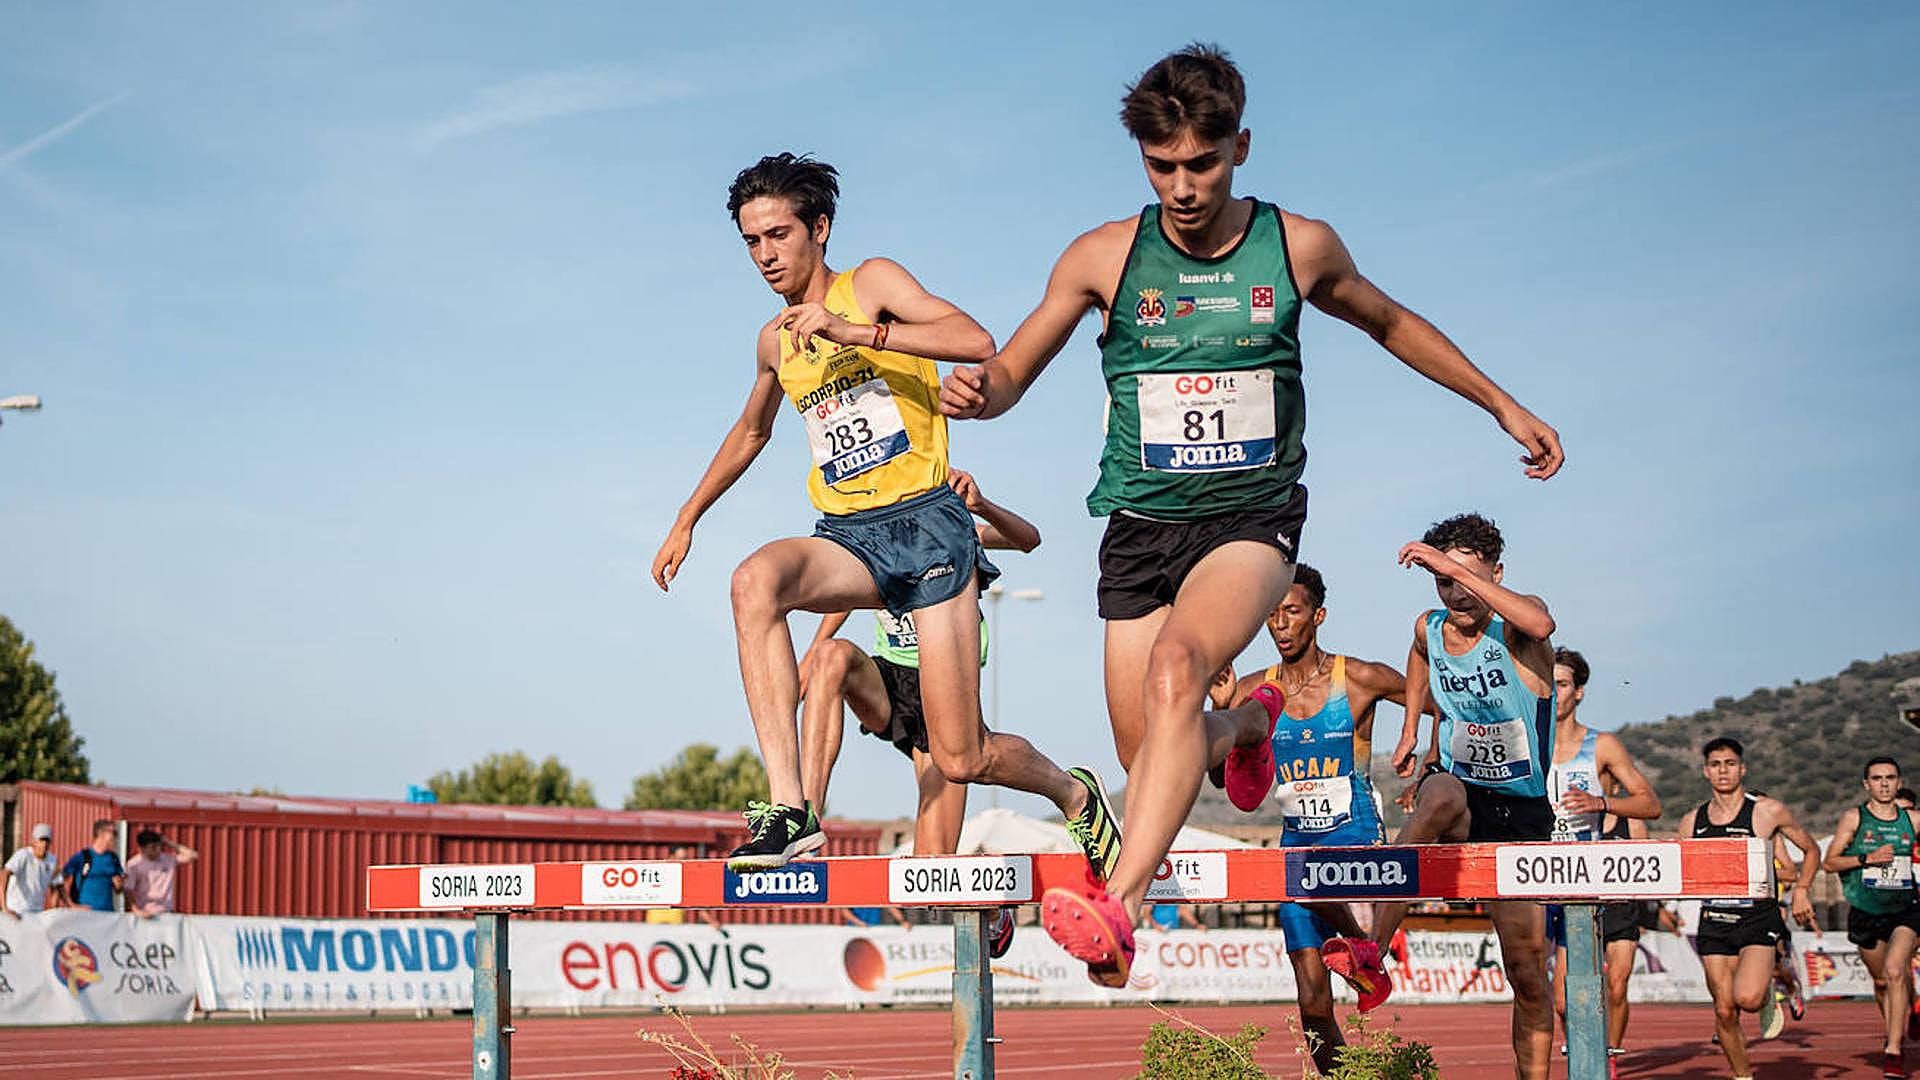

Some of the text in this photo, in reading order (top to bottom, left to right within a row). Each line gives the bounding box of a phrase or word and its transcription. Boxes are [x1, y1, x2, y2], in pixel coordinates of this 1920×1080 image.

[1179, 273, 1219, 284] luanvi
[1184, 409, 1226, 441] 81
[825, 418, 873, 457] 283
[1440, 666, 1508, 698] nerja
[1467, 744, 1506, 765] 228
[1279, 756, 1340, 782] UCAM
[1298, 799, 1332, 816] 114
[1557, 818, 1569, 832] 8
[904, 866, 1017, 893] SORIA 2023
[1153, 858, 1200, 881] Ofit
[1515, 855, 1662, 884] SORIA 2023
[431, 874, 523, 898] SORIA 2023
[561, 929, 771, 993] enovis
[1409, 940, 1475, 958] etismo
[369, 981, 475, 1001] FLOORI
